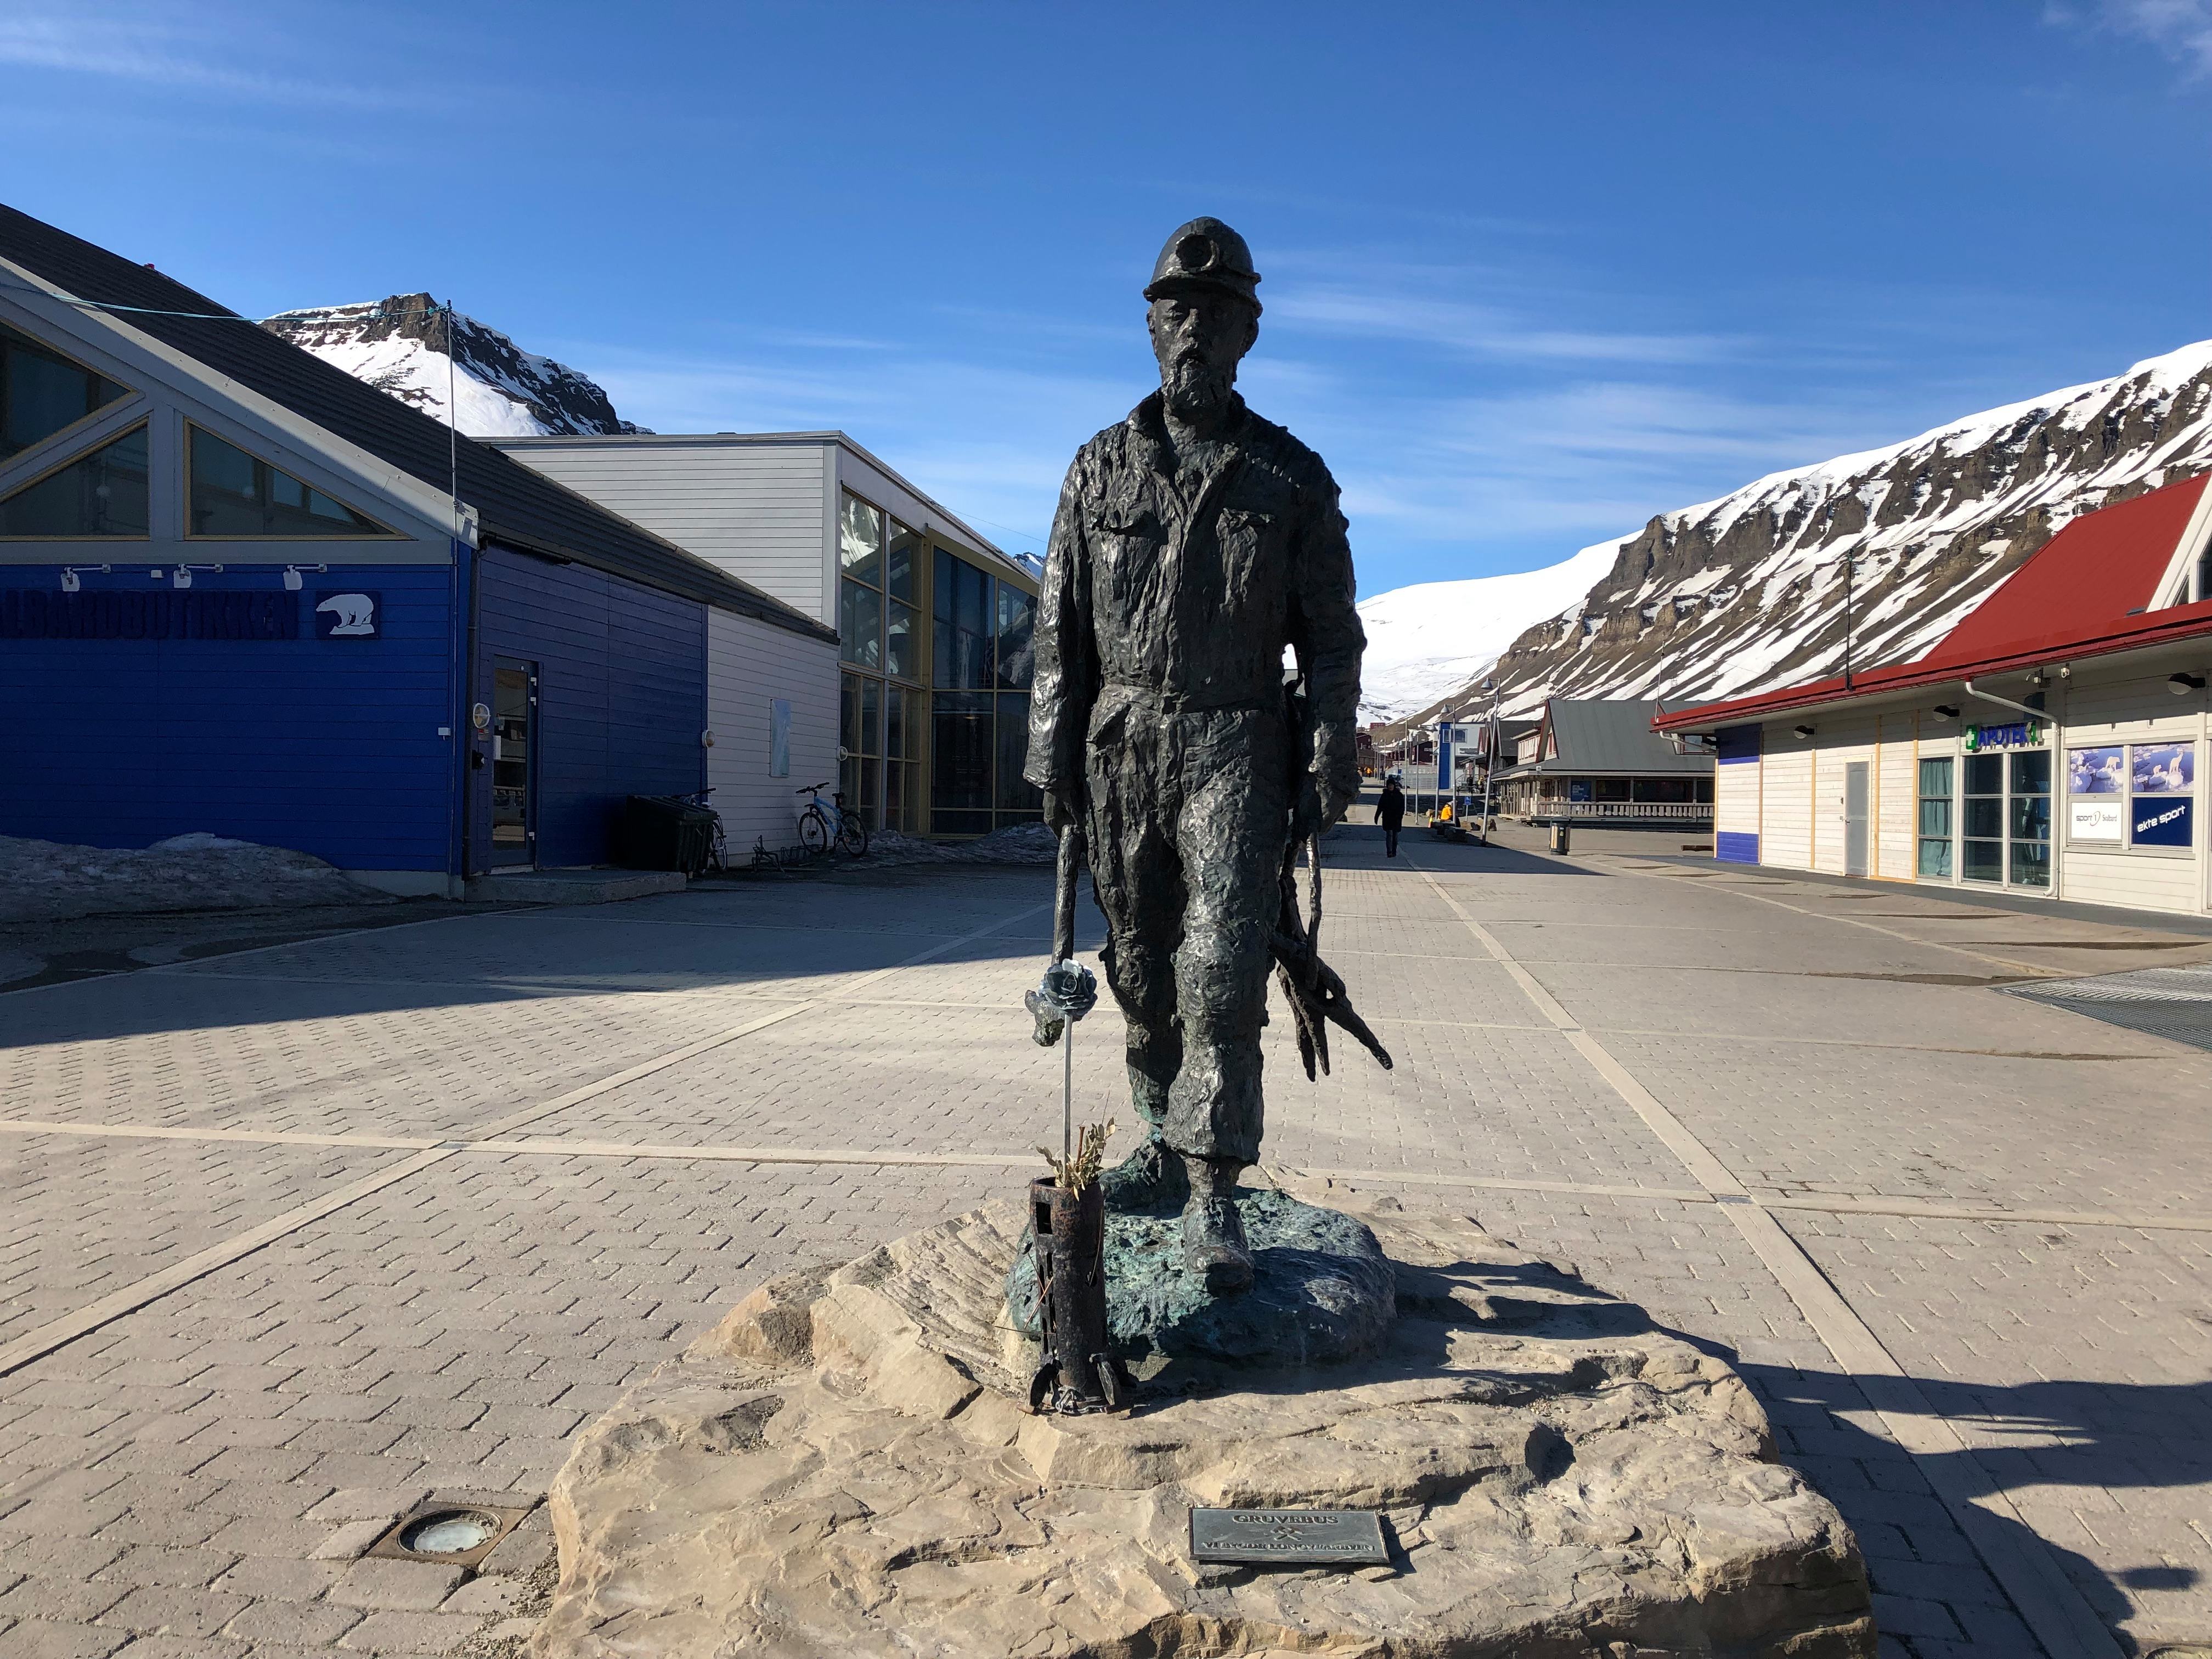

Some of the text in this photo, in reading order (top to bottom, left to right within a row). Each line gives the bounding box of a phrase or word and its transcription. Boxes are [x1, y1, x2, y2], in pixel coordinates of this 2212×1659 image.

[1978, 723, 2028, 746] APOTEK
[2076, 814, 2092, 822] sport
[2137, 805, 2186, 833] ekte sport
[1233, 1514, 1339, 1524] GRUVEBUS
